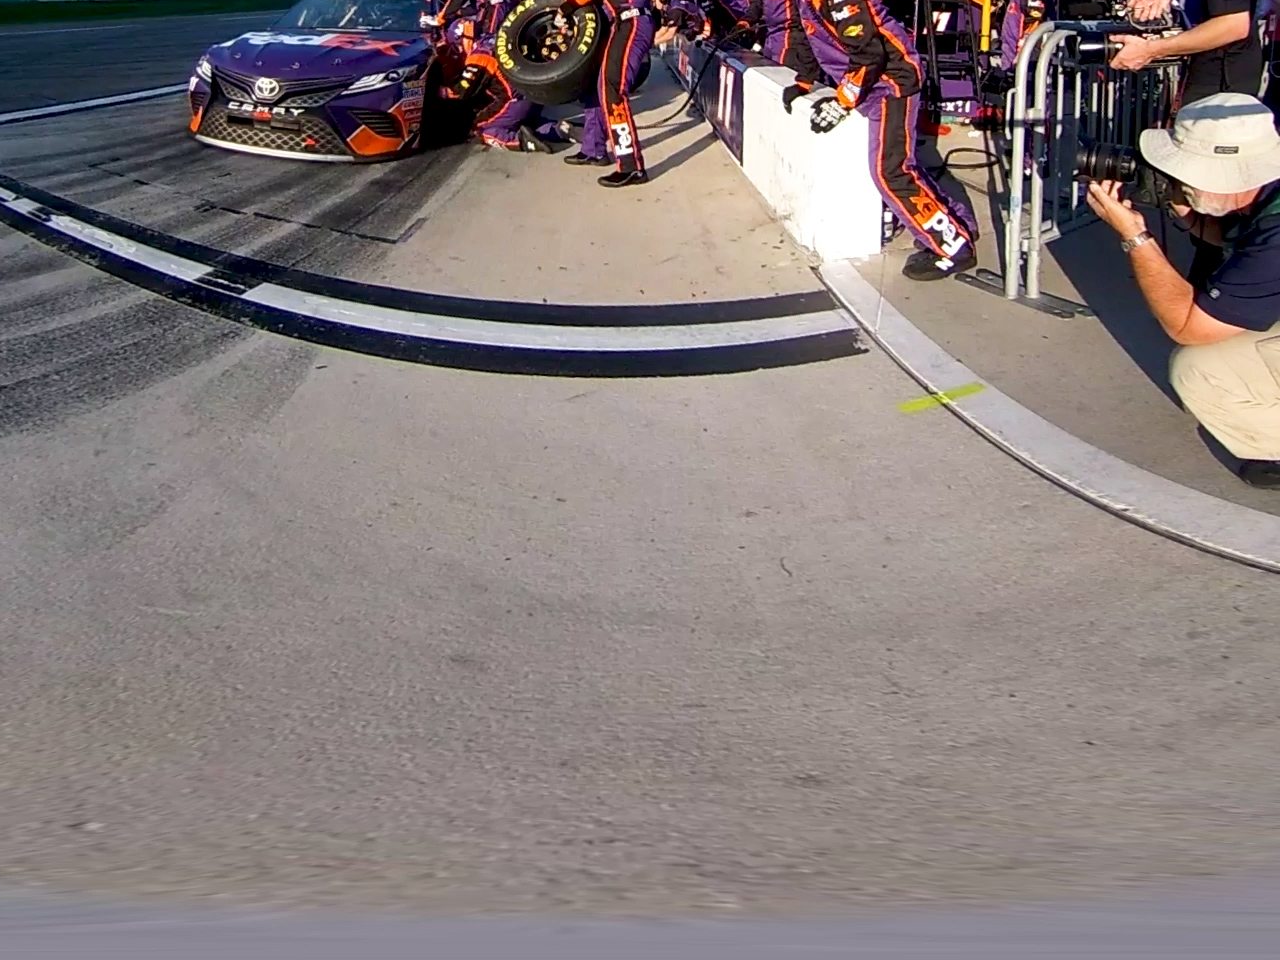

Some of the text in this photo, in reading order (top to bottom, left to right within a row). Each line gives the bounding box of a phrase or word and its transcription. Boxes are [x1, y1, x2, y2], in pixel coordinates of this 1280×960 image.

[577, 12, 594, 55] EAGLE
[228, 101, 306, 117] CAMRY
[717, 64, 735, 130] 11
[609, 103, 634, 156] FedEx
[910, 192, 967, 256] FedEx
